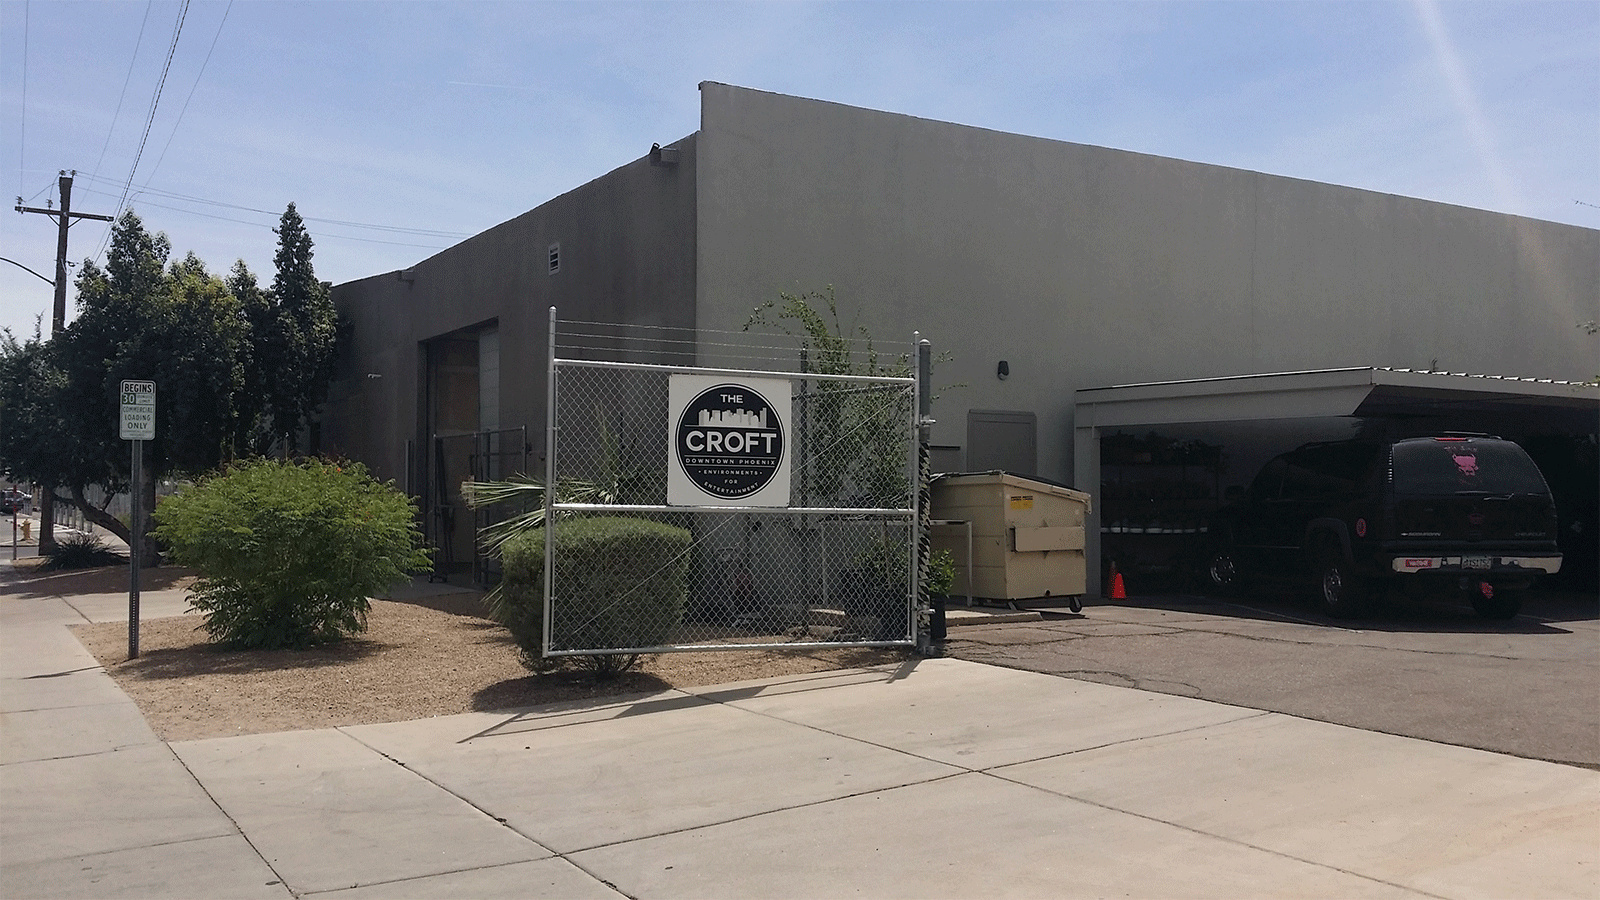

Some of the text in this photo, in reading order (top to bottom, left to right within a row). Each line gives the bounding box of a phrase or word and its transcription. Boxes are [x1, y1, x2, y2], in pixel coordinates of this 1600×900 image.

[124, 383, 152, 393] BEGINS
[122, 394, 135, 404] 30
[720, 394, 744, 404] THE
[127, 421, 148, 430] ONLY
[685, 430, 777, 454] CROFT
[703, 481, 759, 494] ENTERTAINMENT
